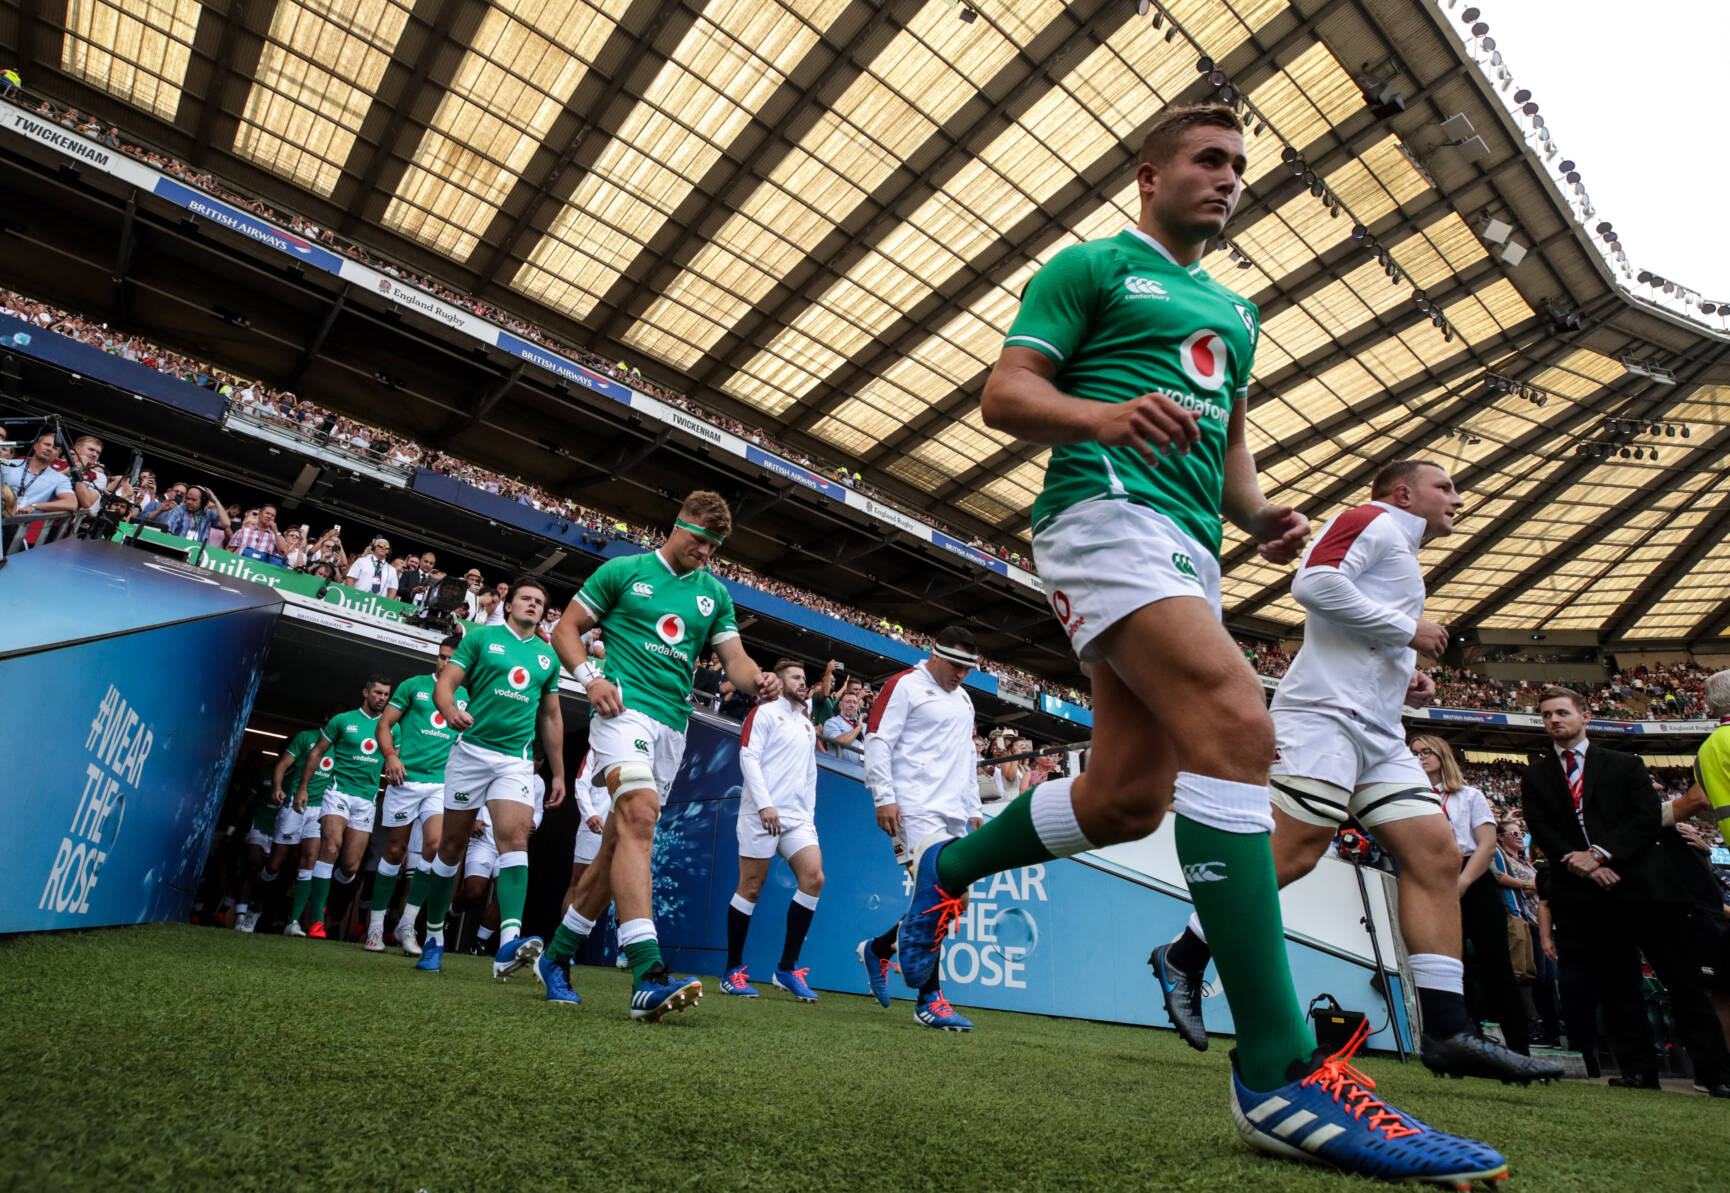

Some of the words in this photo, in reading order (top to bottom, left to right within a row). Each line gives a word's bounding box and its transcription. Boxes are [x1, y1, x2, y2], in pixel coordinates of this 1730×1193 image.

[14, 115, 110, 166] TWICKENHAM
[189, 200, 238, 228] BRITISH
[238, 223, 288, 250] AIRWAYS
[393, 288, 434, 312] England
[435, 307, 465, 327] Rugby
[1125, 293, 1170, 302] canterbury
[521, 349, 556, 370] BRITISH
[556, 366, 593, 387] AIRWAYS
[672, 413, 722, 443] TWICKENHAM
[763, 459, 790, 476] BRITISH
[790, 471, 817, 489] AIRWAYS
[873, 506, 897, 523] England
[897, 515, 914, 531] Rugby
[945, 542, 965, 557] BRITISH
[964, 551, 986, 566] AIRWAYS
[644, 641, 688, 662] vodafone
[494, 688, 530, 703] vodafone
[85, 683, 154, 789] #WEAR
[421, 728, 450, 739] vodafone
[352, 754, 379, 764] vodafone
[70, 762, 120, 844] THE
[38, 836, 107, 914] ROSE
